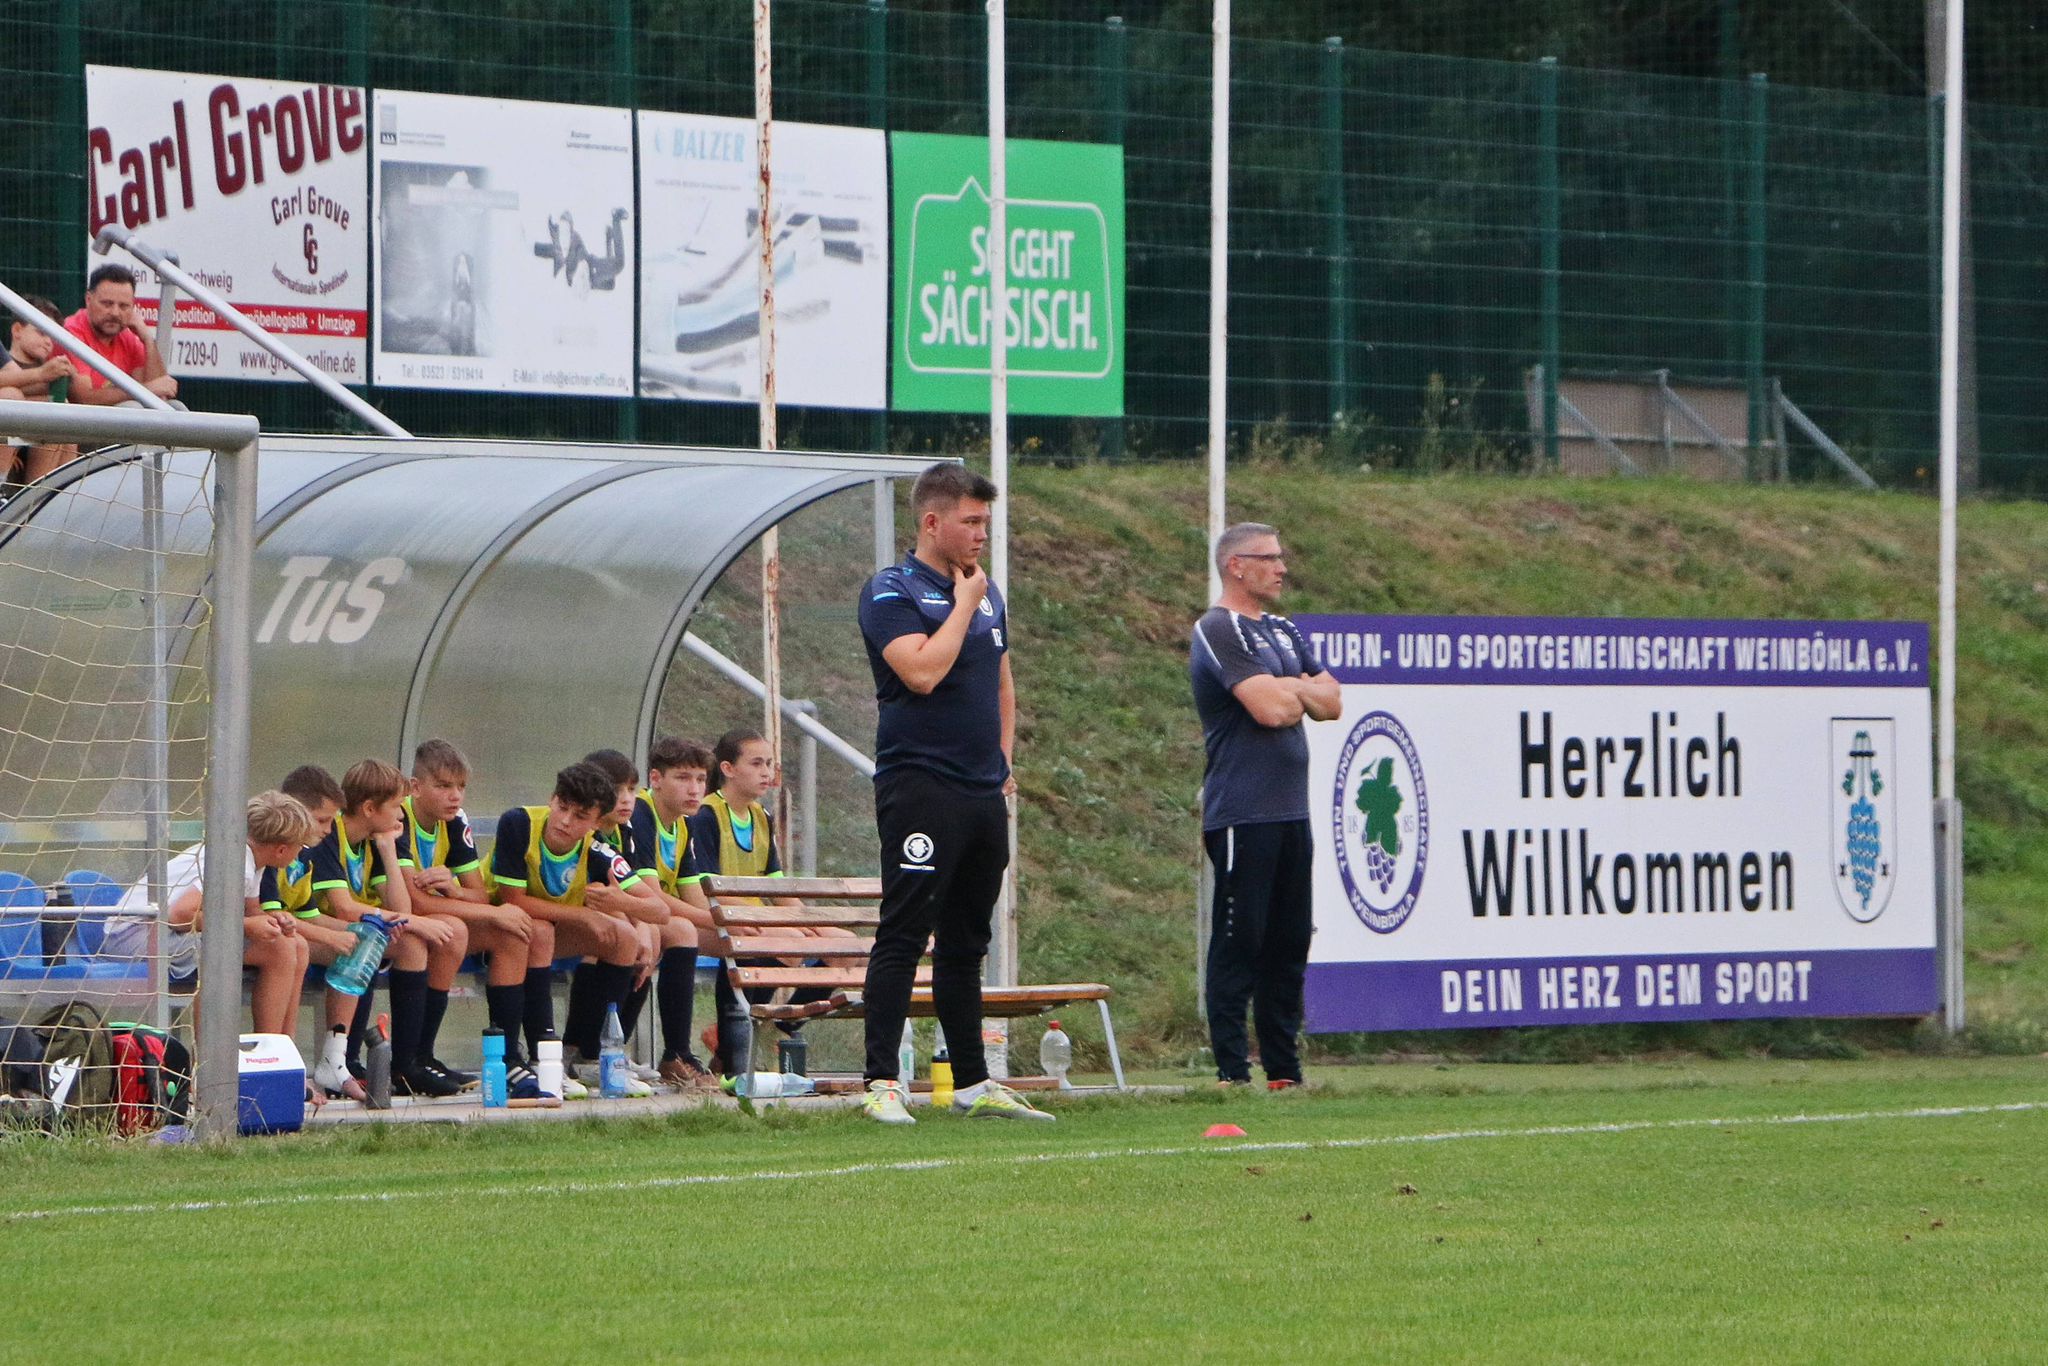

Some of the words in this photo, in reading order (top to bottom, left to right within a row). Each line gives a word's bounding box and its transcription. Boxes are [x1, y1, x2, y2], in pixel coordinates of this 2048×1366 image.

[88, 99, 194, 239] Carl
[208, 83, 364, 195] Grove
[672, 128, 745, 162] BALZER
[271, 186, 302, 226] Carl
[308, 186, 350, 231] Grove
[1010, 228, 1075, 279] GEHT
[173, 305, 216, 327] pedition
[318, 313, 356, 335] Umzüge
[177, 341, 218, 367] 7209-0
[256, 556, 406, 643] TuS
[1310, 632, 1392, 668] TURN-
[1398, 633, 1451, 669] UND
[1457, 634, 1729, 671] SPORTGEMEINSCHAFT
[1733, 630, 1871, 672] WEINBÖHLA
[1874, 638, 1919, 672] e.V.
[1519, 711, 1742, 798] Herzlich
[1461, 828, 1794, 917] Willkommen
[1441, 968, 1523, 1013] DEIN
[1538, 965, 1621, 1010] HERZ
[1635, 963, 1702, 1007] DEM
[1715, 960, 1812, 1004] SPORT
